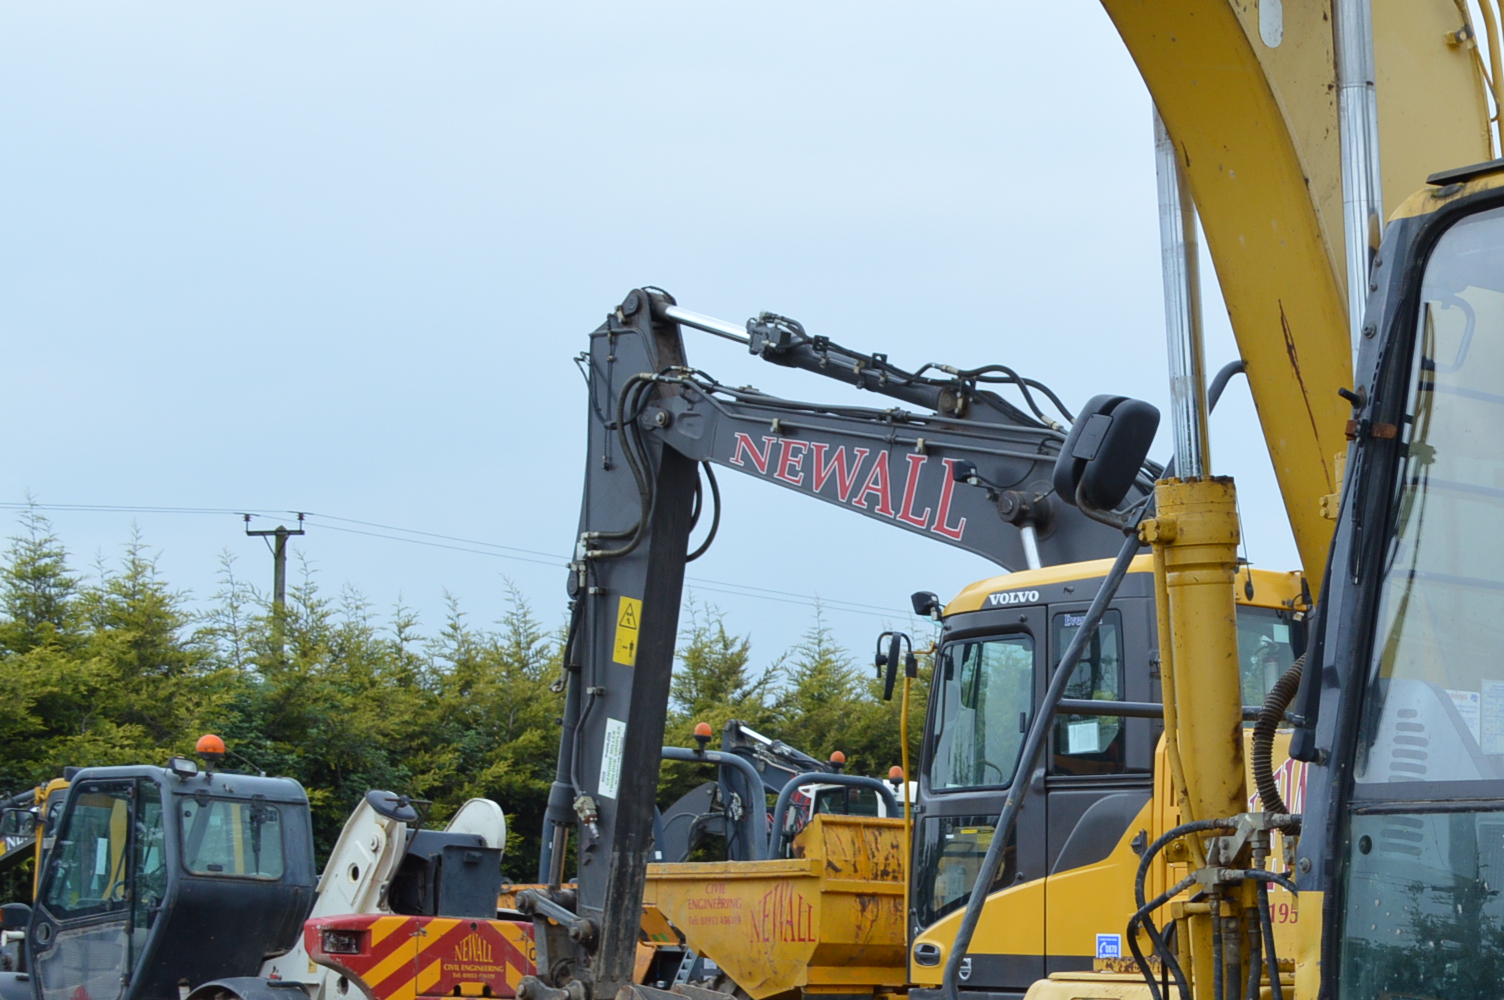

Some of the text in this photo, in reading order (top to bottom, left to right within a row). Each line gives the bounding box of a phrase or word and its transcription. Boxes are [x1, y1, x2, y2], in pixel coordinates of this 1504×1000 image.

[730, 432, 967, 541] NEWALL
[989, 590, 1040, 606] VOLVO
[749, 880, 817, 944] NEWALL
[455, 932, 494, 962] NEWALL
